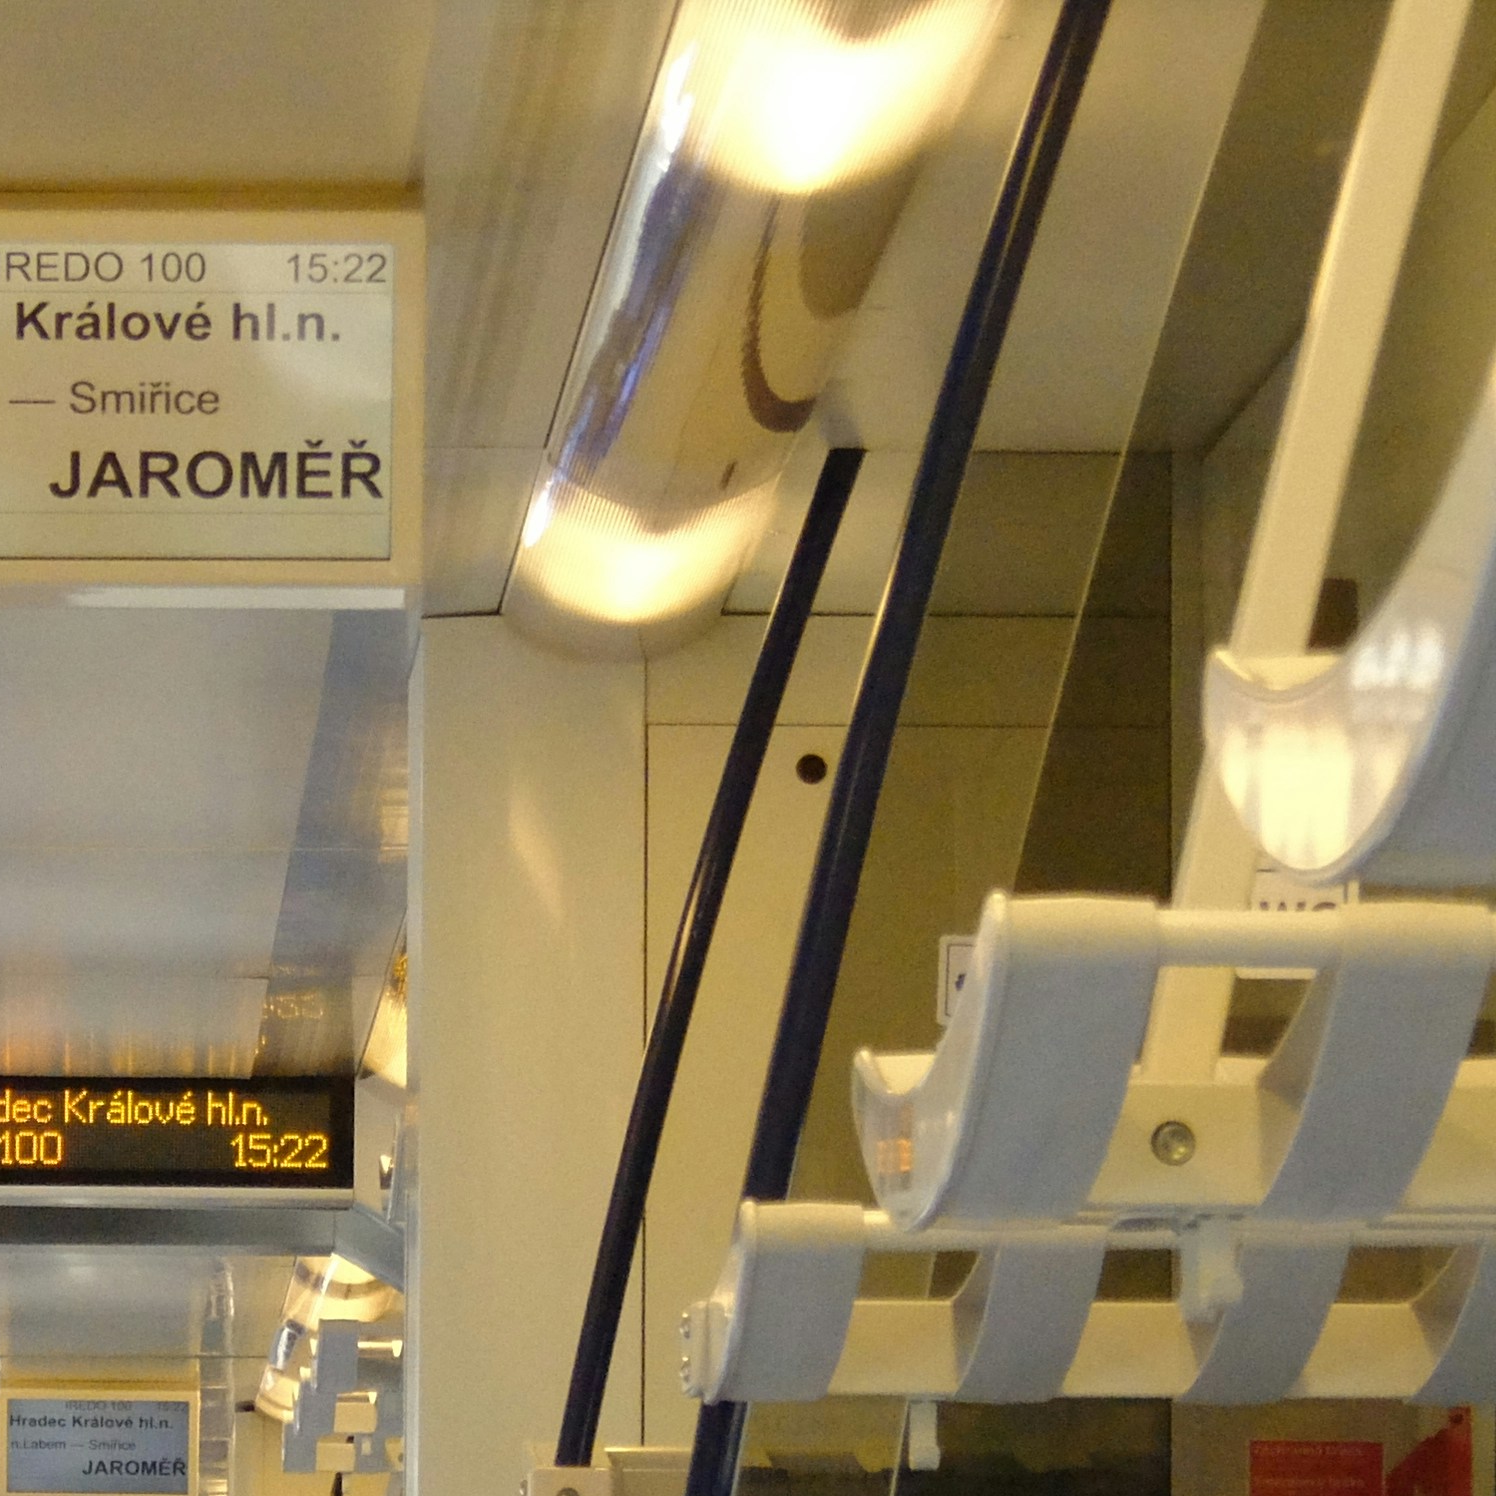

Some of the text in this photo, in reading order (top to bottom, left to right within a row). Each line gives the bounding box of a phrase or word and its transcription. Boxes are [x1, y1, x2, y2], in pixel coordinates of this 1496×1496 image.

[139, 252, 208, 284] 100
[286, 252, 388, 284] 15:22
[15, 300, 212, 342] Králové
[232, 302, 342, 342] hl.n.
[68, 381, 221, 415] Smiřice
[49, 439, 384, 500] JAROMĚŘ
[63, 1089, 196, 1127] Králové
[207, 1092, 269, 1127] hl.n.
[229, 1131, 329, 1169] 15:22
[9, 1415, 66, 1428] Hradec
[71, 1415, 134, 1429] Králové
[82, 1457, 187, 1477] JAROMĚŘ
